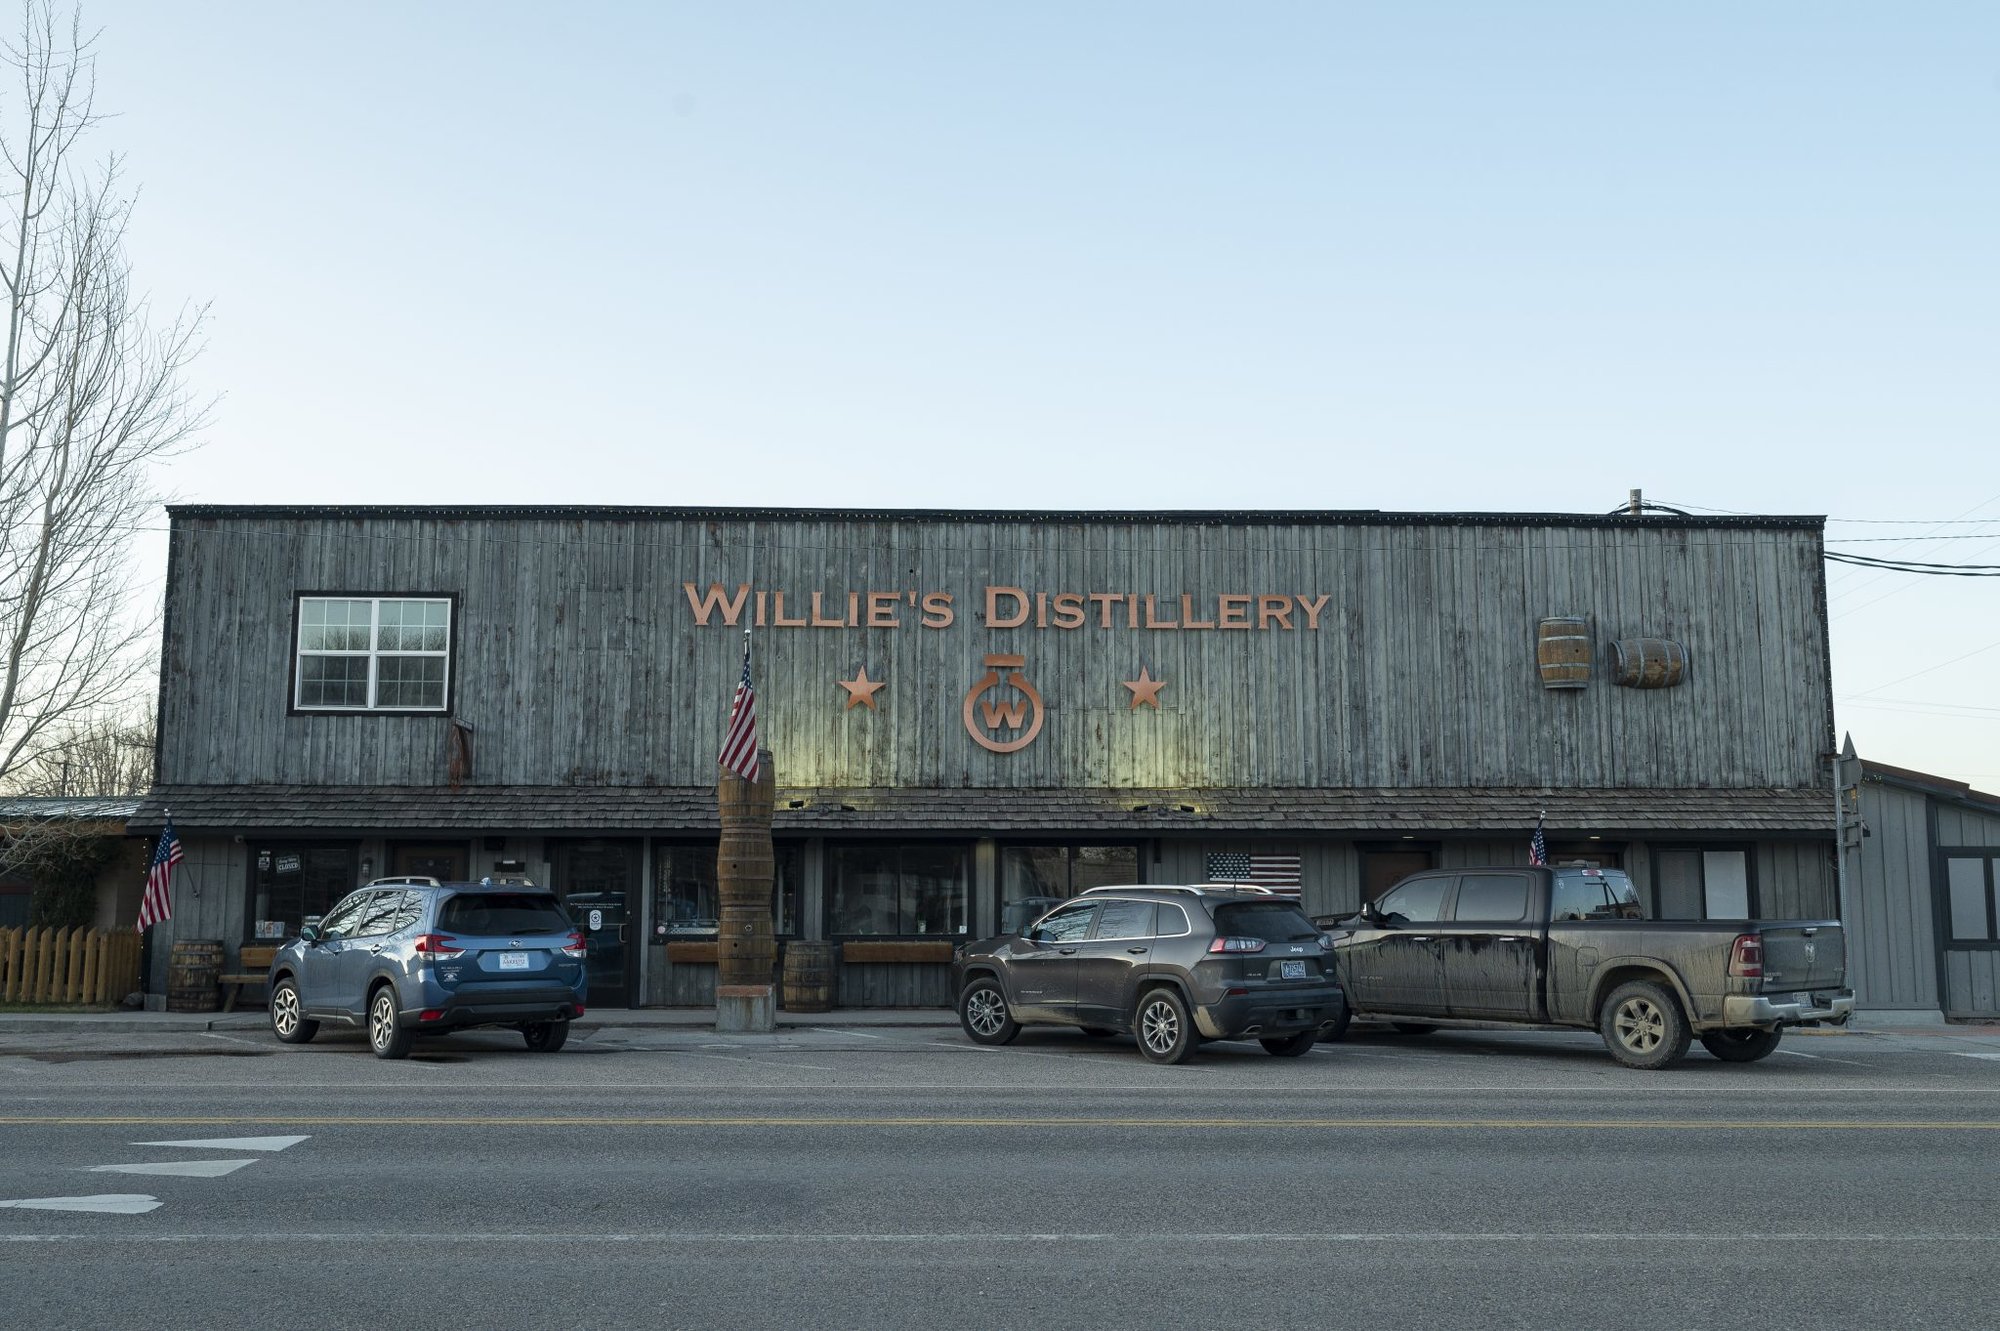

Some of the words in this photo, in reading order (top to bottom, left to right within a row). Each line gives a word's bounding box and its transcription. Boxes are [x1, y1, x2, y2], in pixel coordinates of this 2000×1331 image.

[683, 583, 955, 629] WILLIE'S
[985, 586, 1331, 630] DISTILLERY
[981, 701, 1028, 729] W
